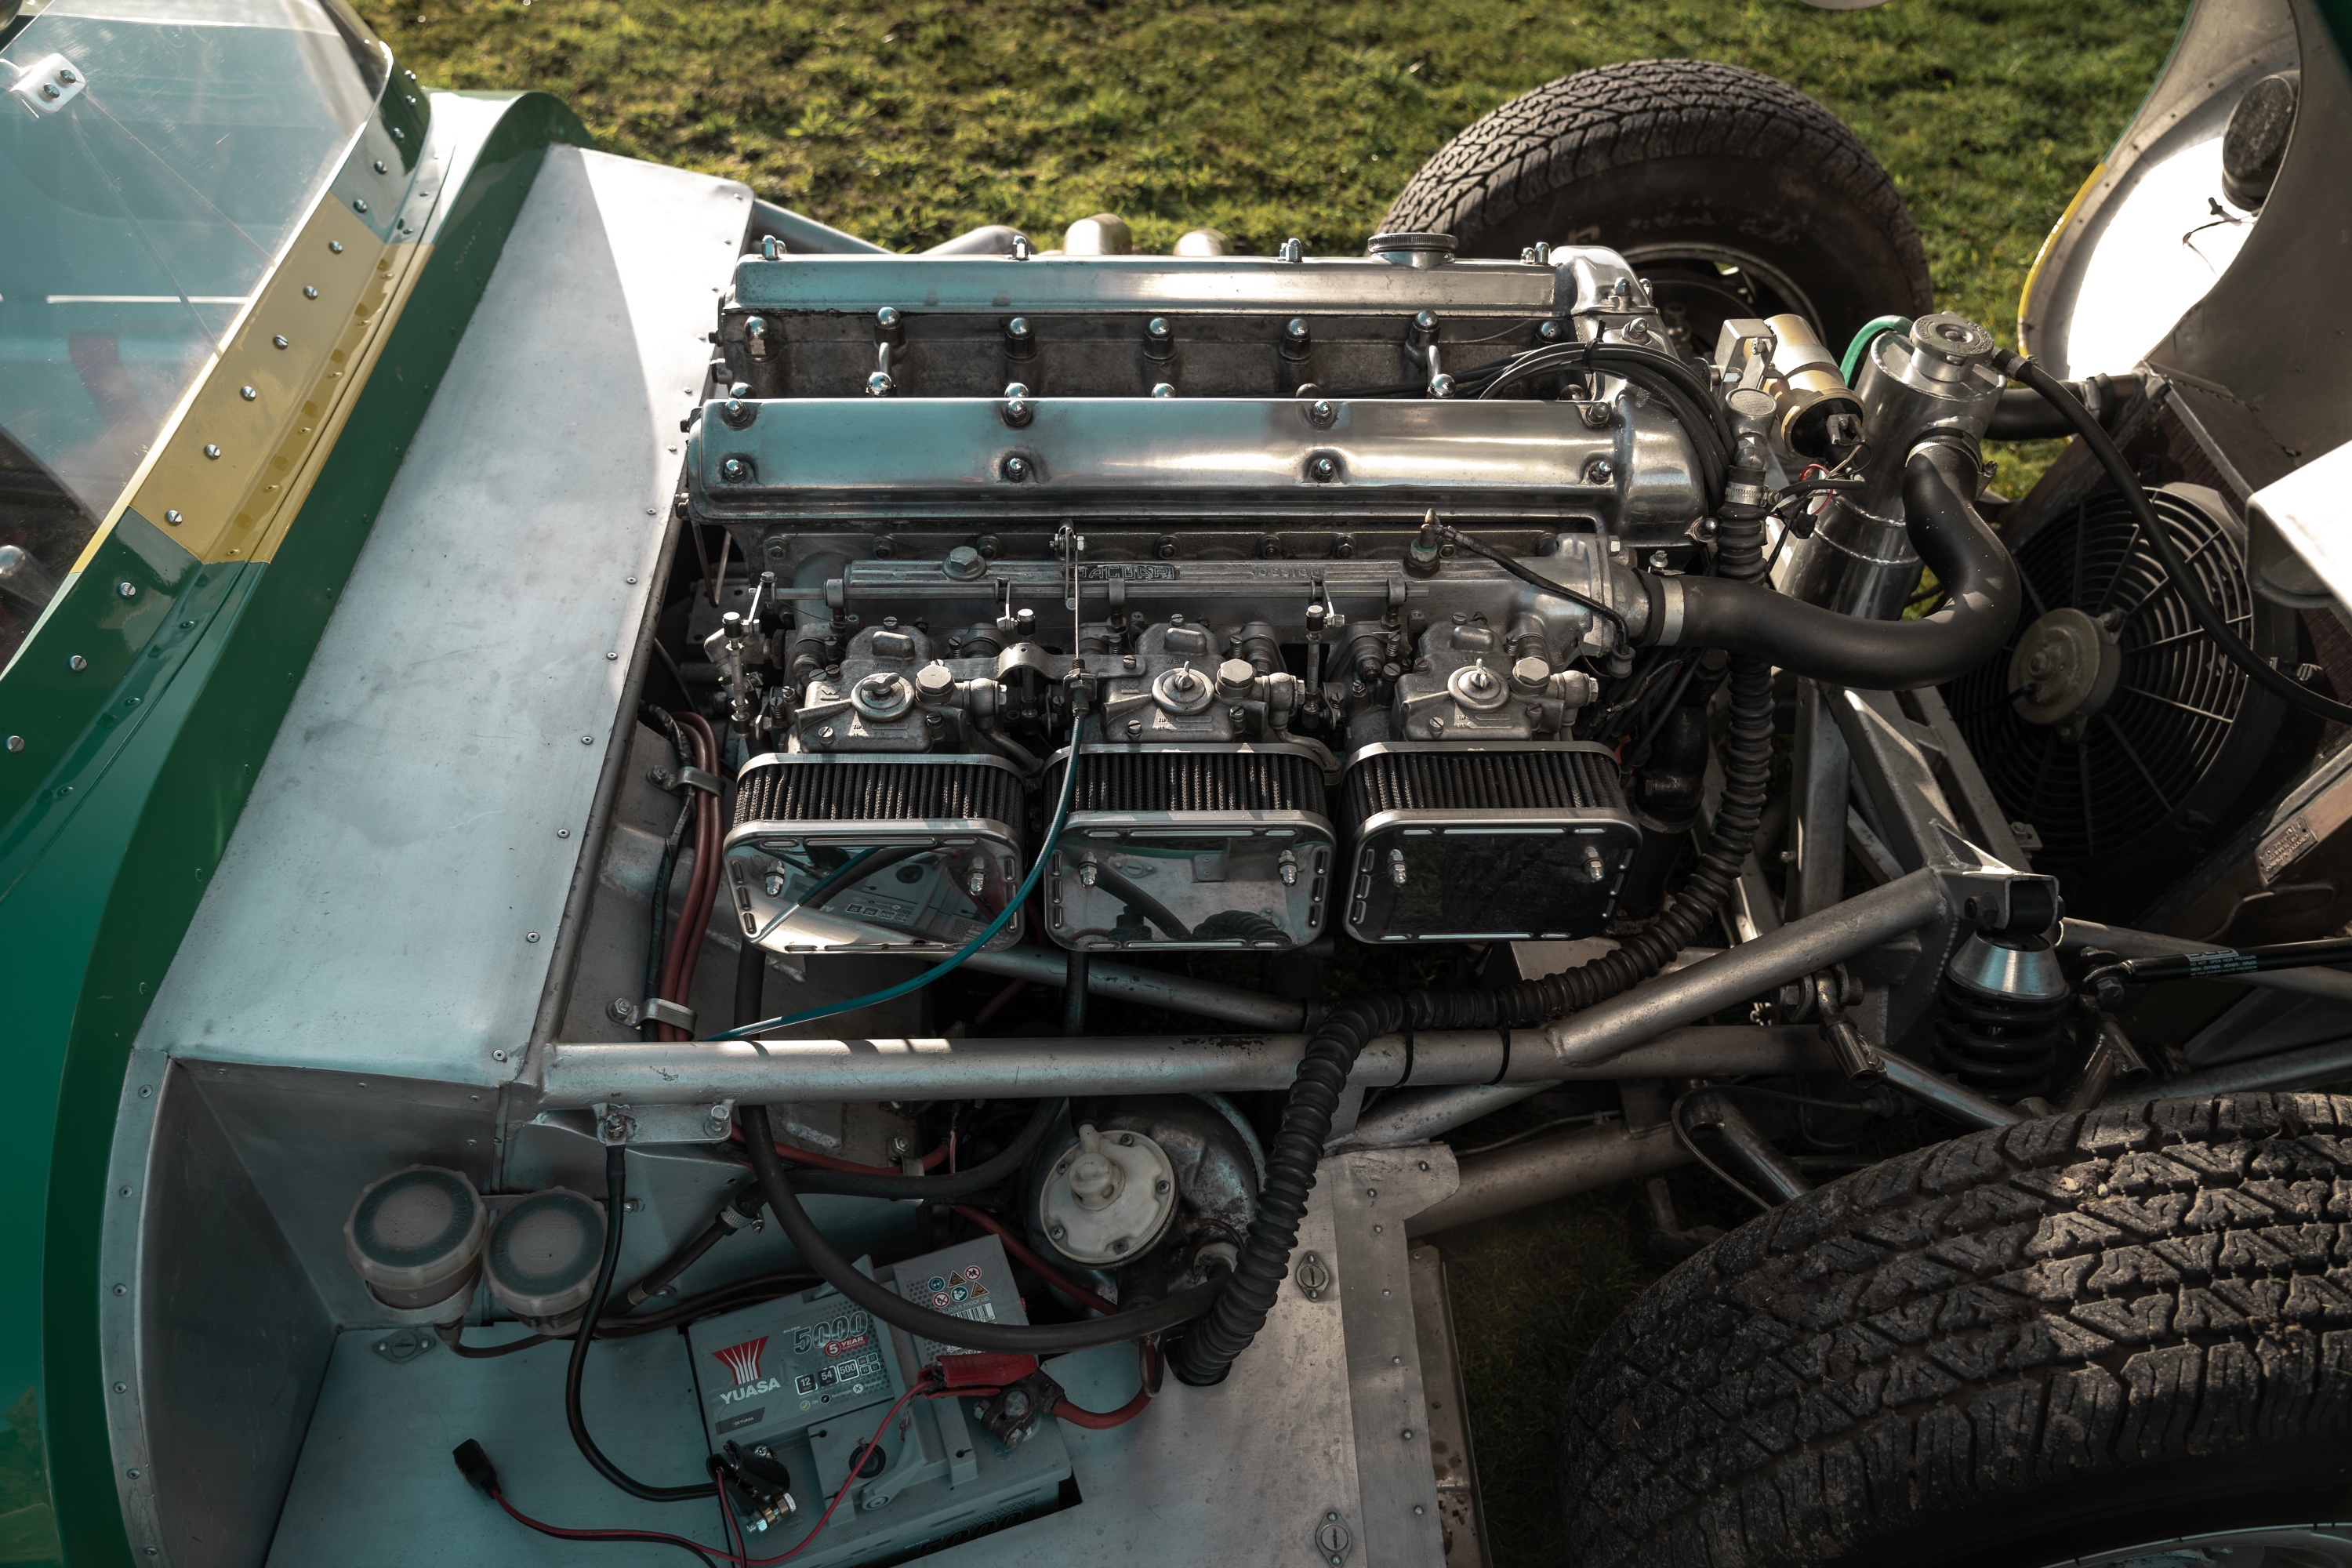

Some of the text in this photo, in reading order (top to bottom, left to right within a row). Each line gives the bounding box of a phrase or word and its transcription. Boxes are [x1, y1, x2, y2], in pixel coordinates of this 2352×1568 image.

[1069, 565, 1323, 579] JAGUAR DESIGN
[413, 1193, 440, 1210] KEEP
[541, 1210, 565, 1219] FULL
[378, 1208, 427, 1243] RESERVOIR
[521, 1221, 579, 1231] RESERVOIR
[380, 1225, 403, 1243] FULL
[528, 1250, 558, 1260] KEEP
[963, 1299, 980, 1308] PROOF
[794, 1310, 867, 1355] 5000
[829, 1336, 864, 1354] 5 YEAR
[842, 1340, 866, 1351] GUARANTEE
[840, 1363, 855, 1374] 500
[821, 1370, 833, 1381] 54
[800, 1377, 811, 1387] 12
[720, 1377, 782, 1405] YUASA
[831, 1389, 852, 1399] Recharge
[905, 1538, 930, 1549] SILVER
